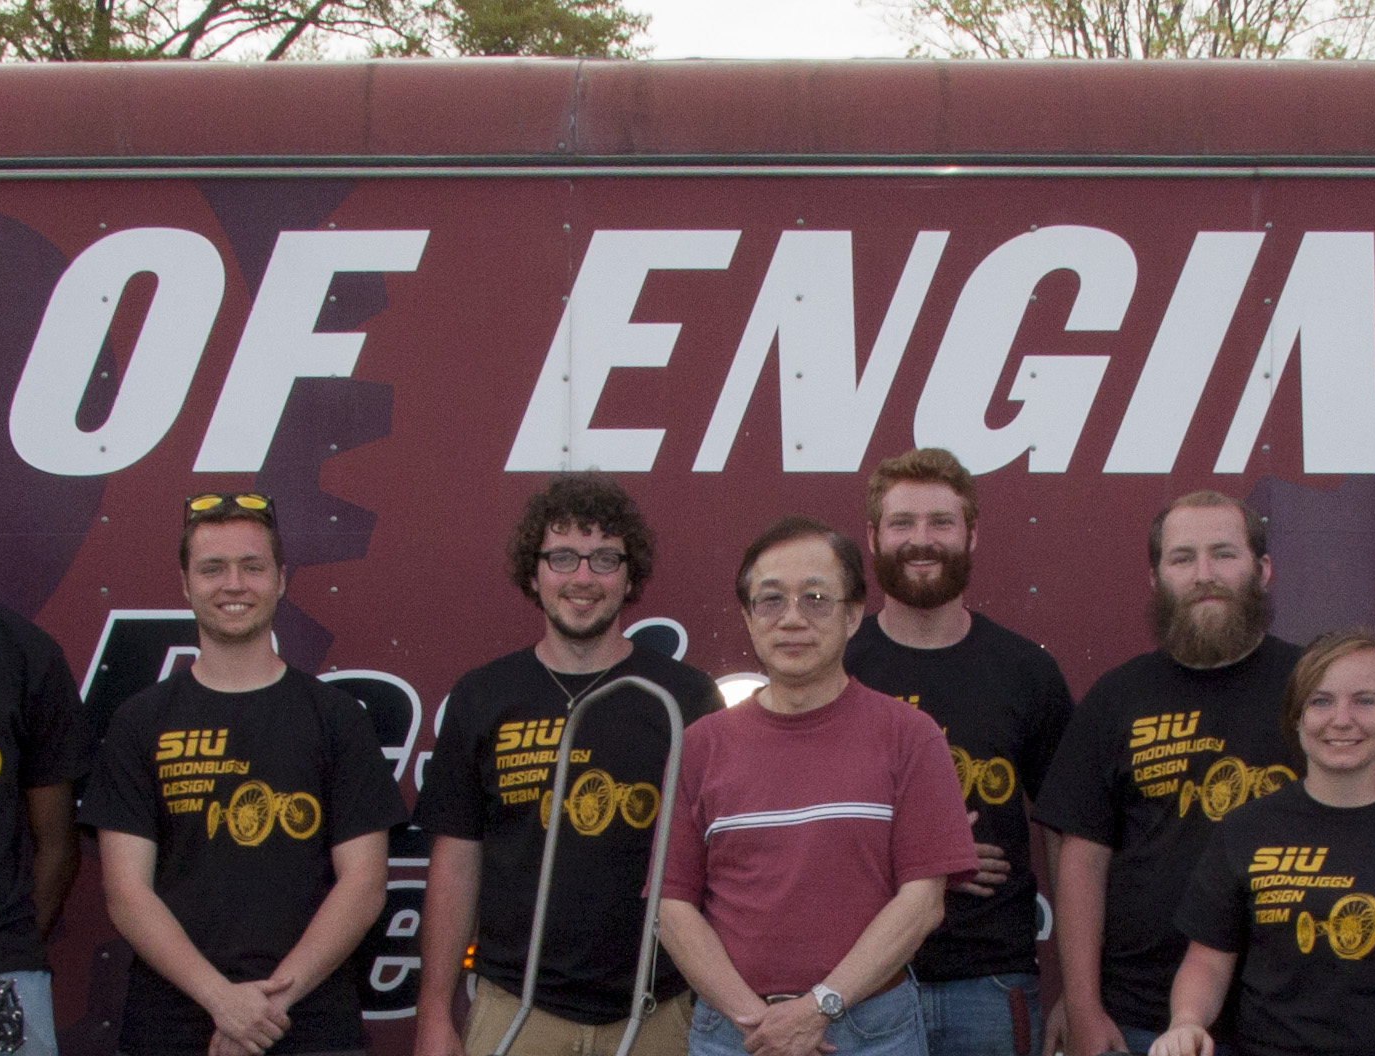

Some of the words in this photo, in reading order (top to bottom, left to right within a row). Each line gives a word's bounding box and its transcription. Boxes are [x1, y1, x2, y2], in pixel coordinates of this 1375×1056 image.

[8, 226, 431, 477] OF
[495, 717, 566, 752] SIU
[1129, 710, 1201, 749] SIU
[155, 728, 228, 761] SIU
[1131, 737, 1225, 766] MOONBUGGY
[158, 759, 250, 779] MOONBUGGY
[496, 749, 592, 770] MOONBUGY
[1134, 758, 1188, 782] DESIGN
[163, 779, 215, 797] DESIGN
[498, 767, 549, 787] DESIGN
[1247, 846, 1329, 873] SIU
[1250, 874, 1355, 892] MOONBUGGY
[1254, 889, 1306, 905] DESIGN
